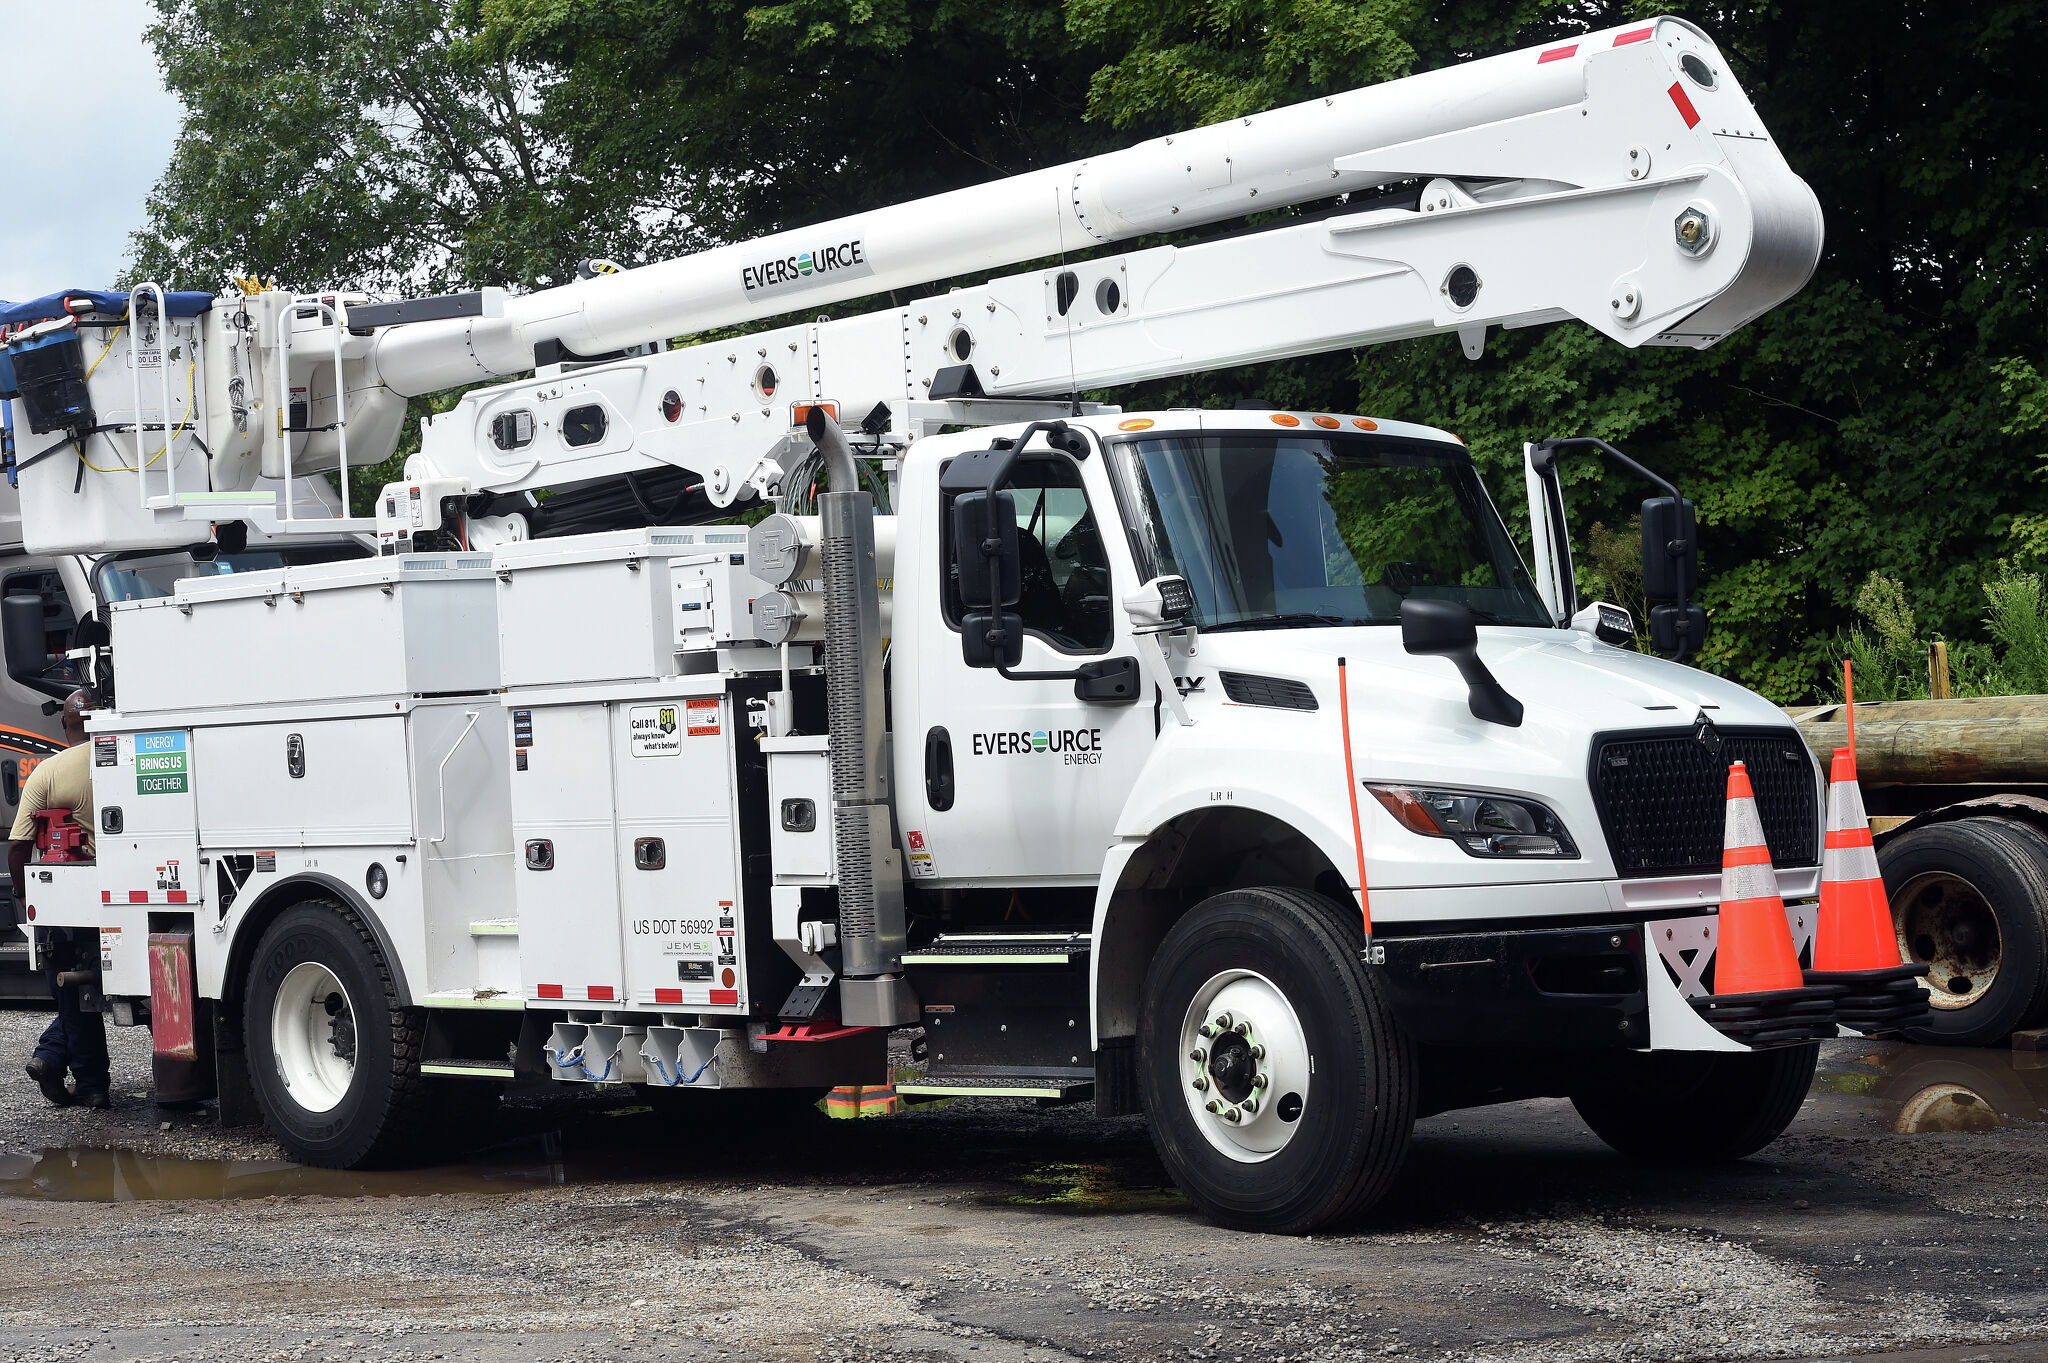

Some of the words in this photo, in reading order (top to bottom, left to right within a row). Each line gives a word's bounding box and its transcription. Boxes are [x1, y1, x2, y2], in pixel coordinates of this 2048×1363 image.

[742, 240, 864, 290] EVERSOURCE
[631, 719, 644, 729] Call
[644, 719, 658, 729] 811,
[660, 709, 674, 725] 811
[145, 735, 175, 749] ENERGY
[633, 733, 651, 741] always
[972, 728, 1102, 756] EVERSOURCE
[644, 742, 661, 750] what's
[661, 741, 679, 749] below!
[140, 758, 170, 771] BRINGS
[170, 757, 182, 769] US
[1063, 752, 1103, 766] ENERGY
[141, 778, 182, 791] TOGETHER
[633, 919, 650, 934] US
[653, 919, 677, 934] DOT
[680, 919, 714, 935] 56992
[666, 942, 702, 950] JEMS
